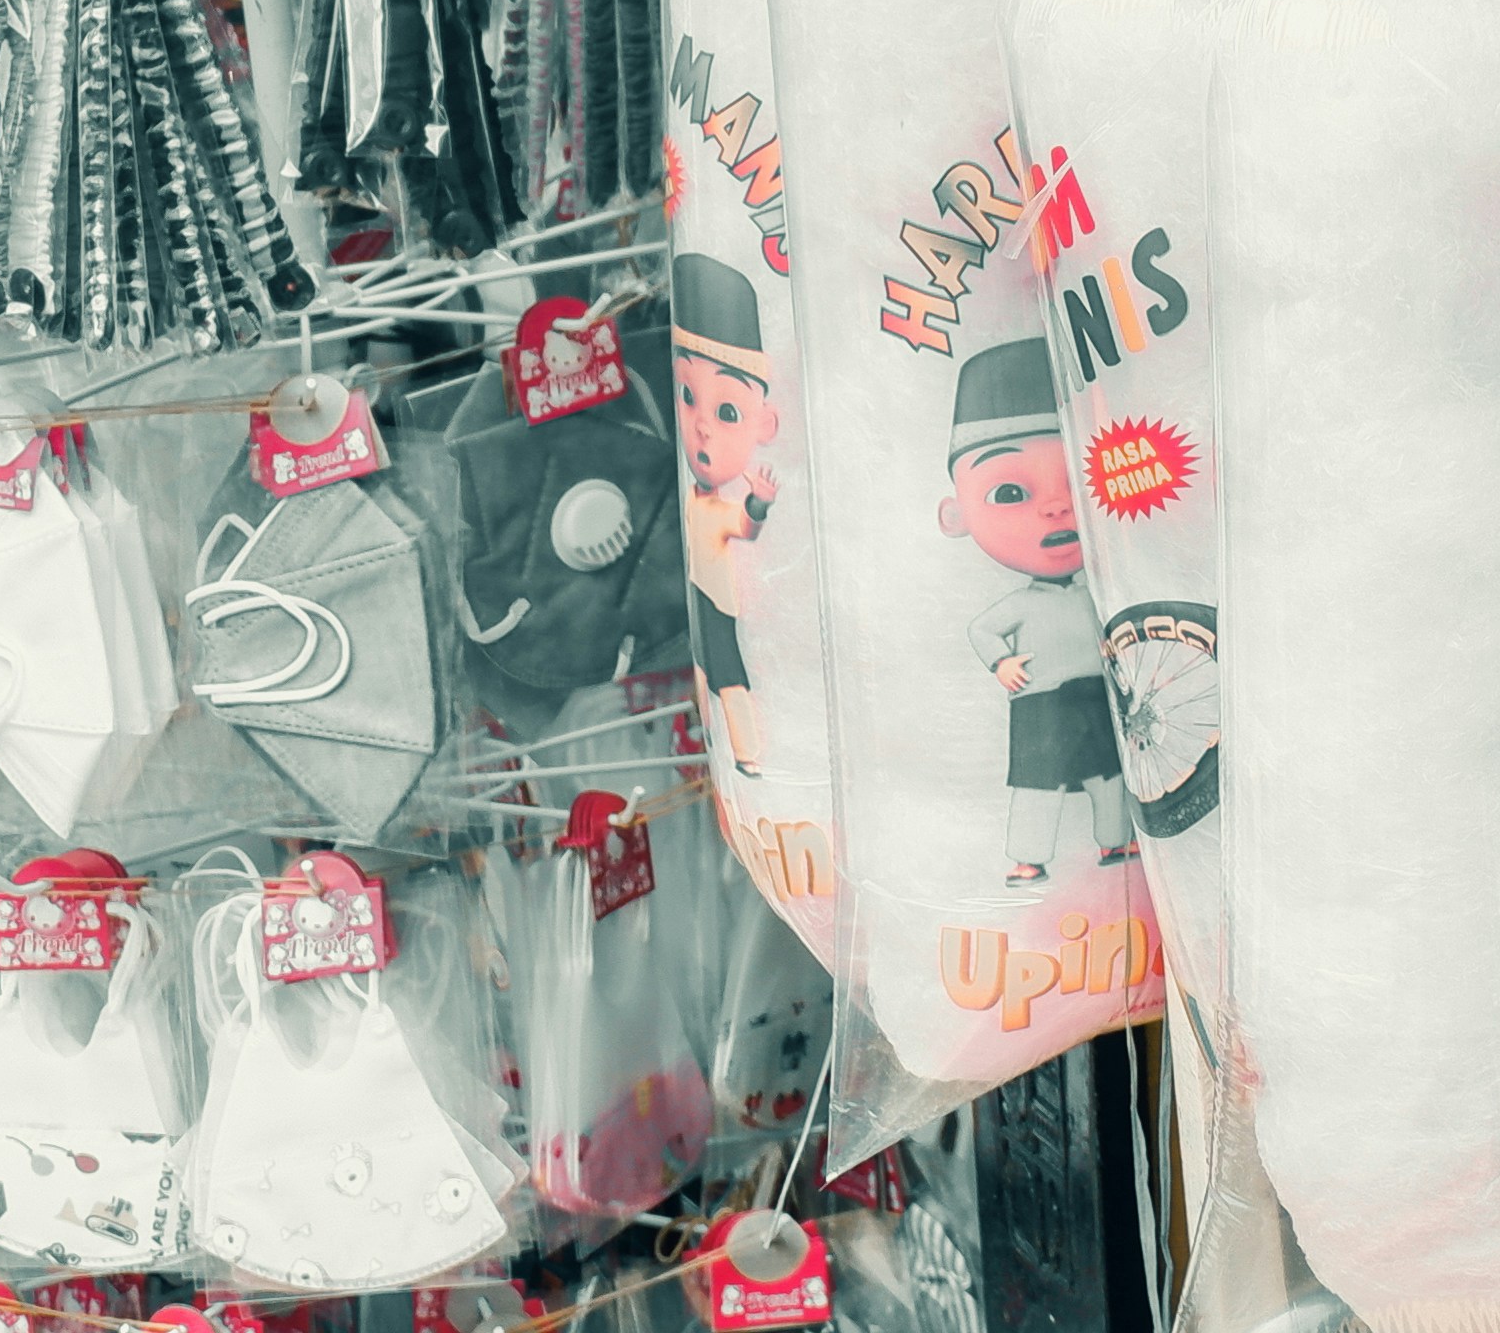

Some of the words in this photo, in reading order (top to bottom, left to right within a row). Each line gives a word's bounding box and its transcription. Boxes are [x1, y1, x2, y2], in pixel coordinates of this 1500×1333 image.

[1101, 437, 1157, 474] RASA
[1105, 461, 1174, 502] PRIMA
[15, 929, 83, 955] Trend
[286, 929, 355, 960] Trend
[941, 914, 1149, 1033] Upin
[151, 1206, 168, 1246] ARE
